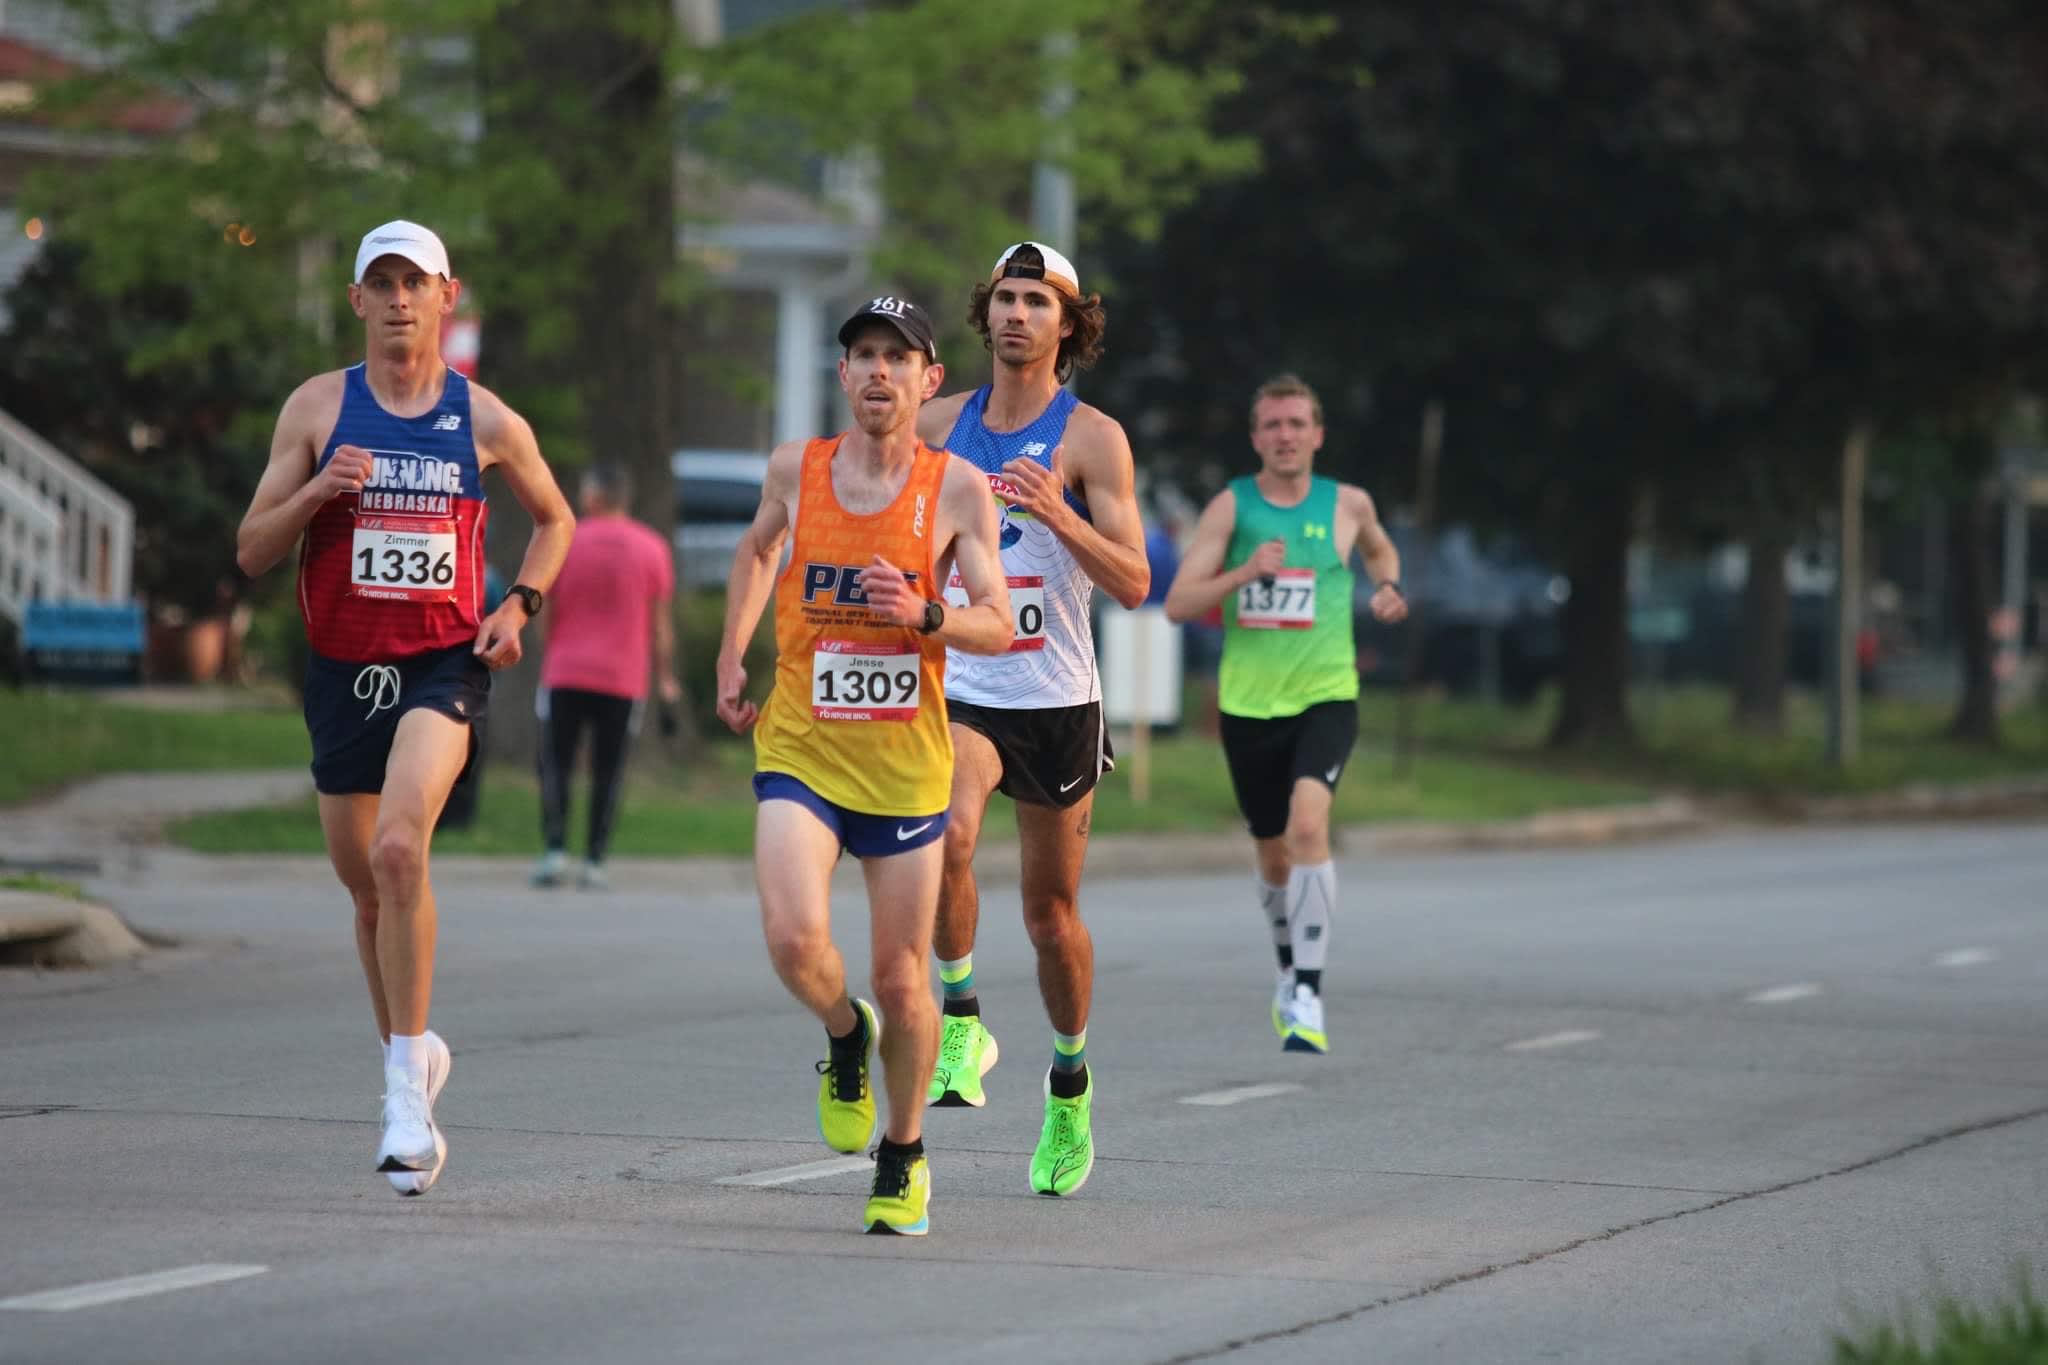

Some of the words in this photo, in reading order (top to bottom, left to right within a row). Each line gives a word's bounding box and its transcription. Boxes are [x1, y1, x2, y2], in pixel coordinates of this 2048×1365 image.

[363, 457, 463, 493] UNNING.
[362, 492, 447, 512] NEBRASKA
[384, 534, 430, 547] Zimmer
[357, 547, 453, 585] 1336
[802, 563, 919, 608] PB
[1243, 587, 1312, 611] 1377
[849, 658, 884, 668] Jesse
[818, 670, 918, 704] 1309
